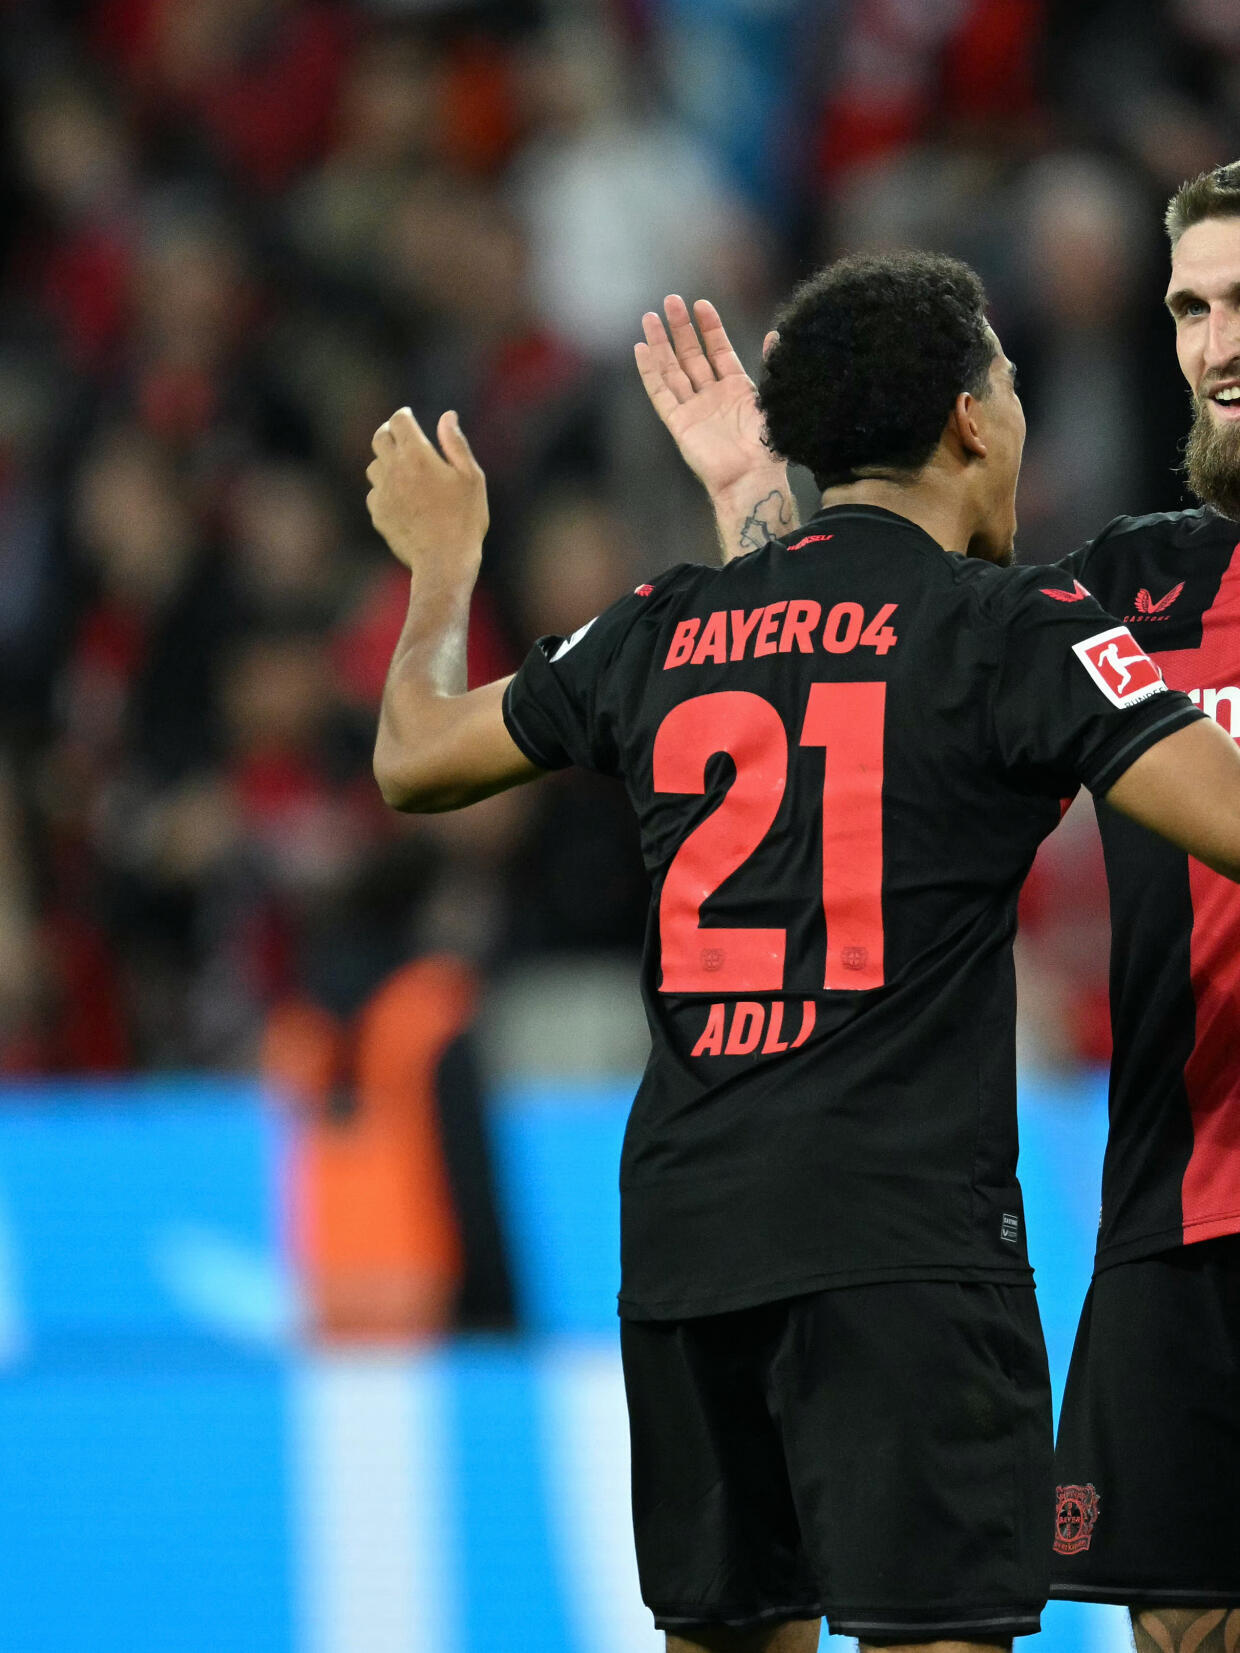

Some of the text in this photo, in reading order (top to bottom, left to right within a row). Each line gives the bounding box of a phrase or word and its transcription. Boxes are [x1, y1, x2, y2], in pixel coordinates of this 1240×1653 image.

[663, 600, 899, 671] BAYER 04
[653, 681, 886, 992] 21
